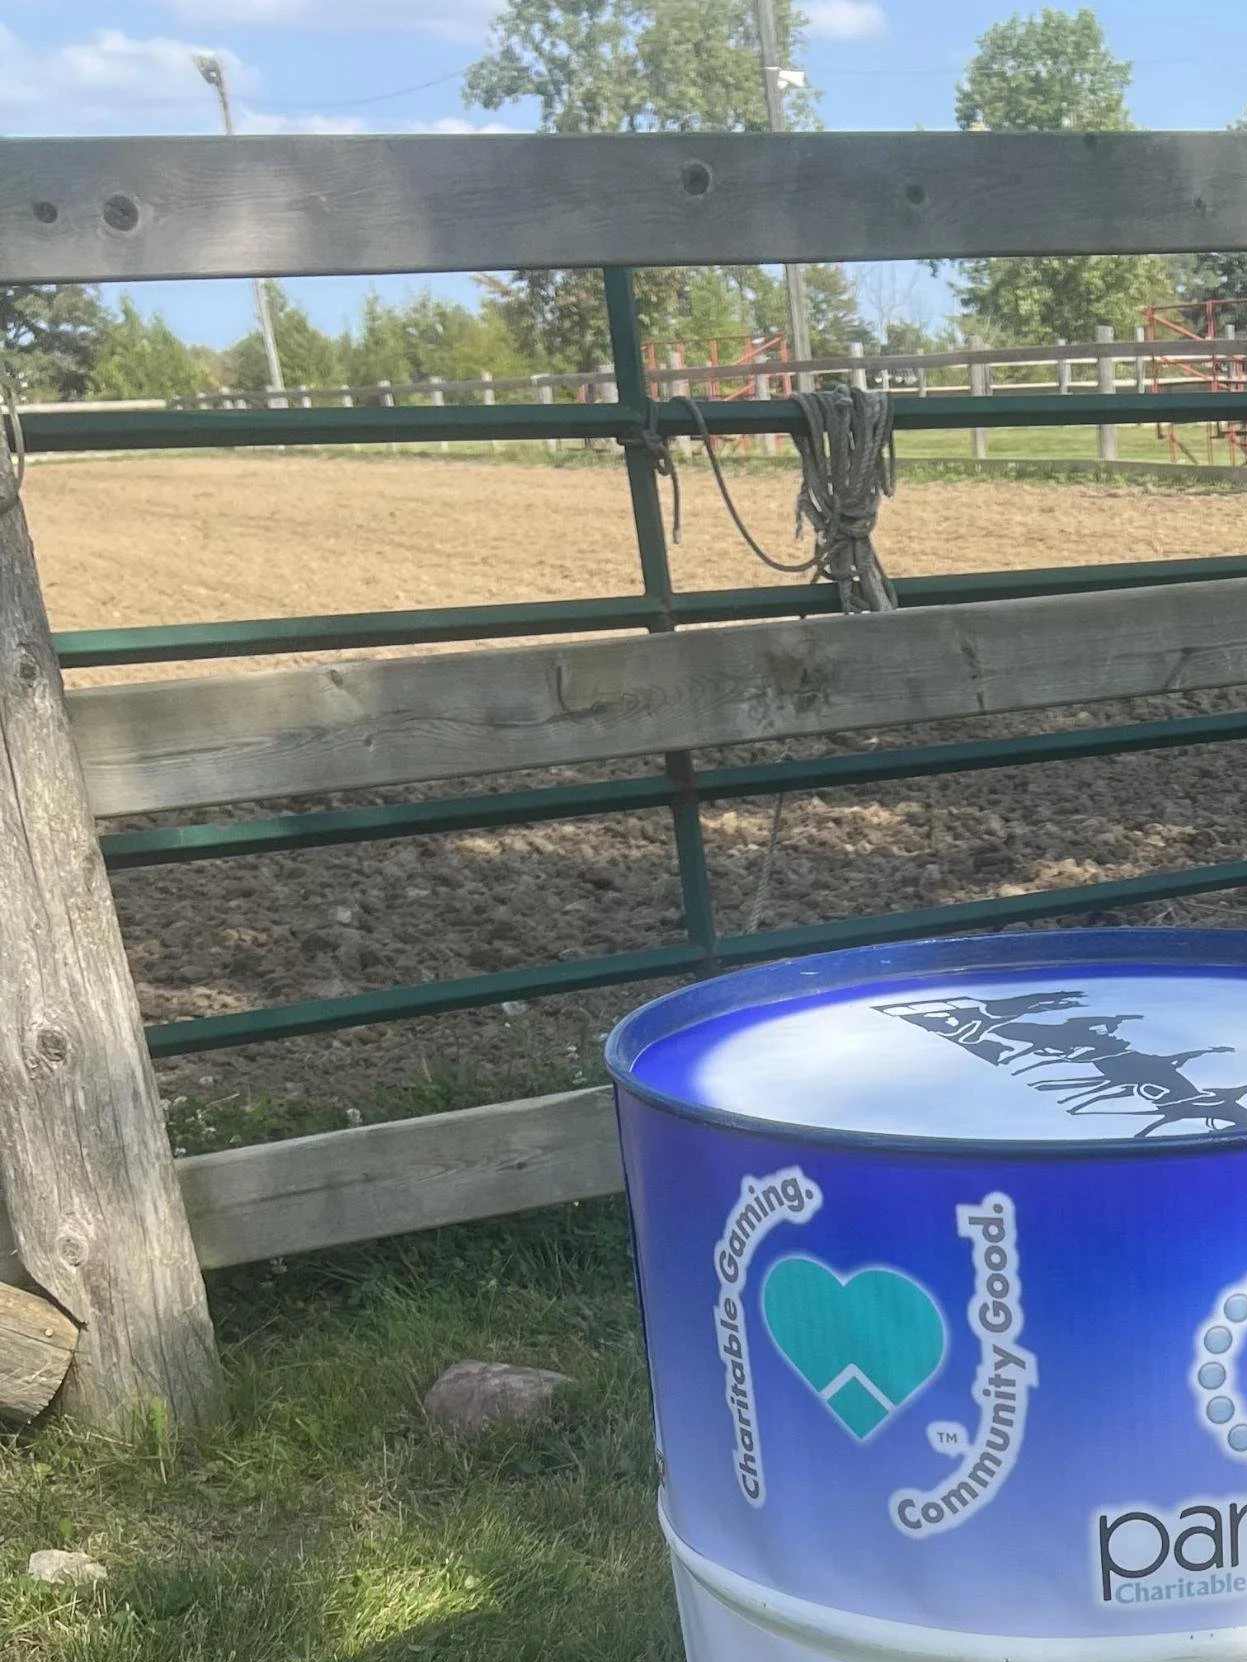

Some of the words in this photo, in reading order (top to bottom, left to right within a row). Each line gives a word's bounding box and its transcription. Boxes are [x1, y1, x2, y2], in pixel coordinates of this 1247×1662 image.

[719, 1177, 814, 1283] Gaming.
[719, 1297, 760, 1499] Charitable
[896, 1343, 1026, 1530] Community
[968, 1202, 1013, 1333] Good.
[1115, 1573, 1246, 1604] Charitable
